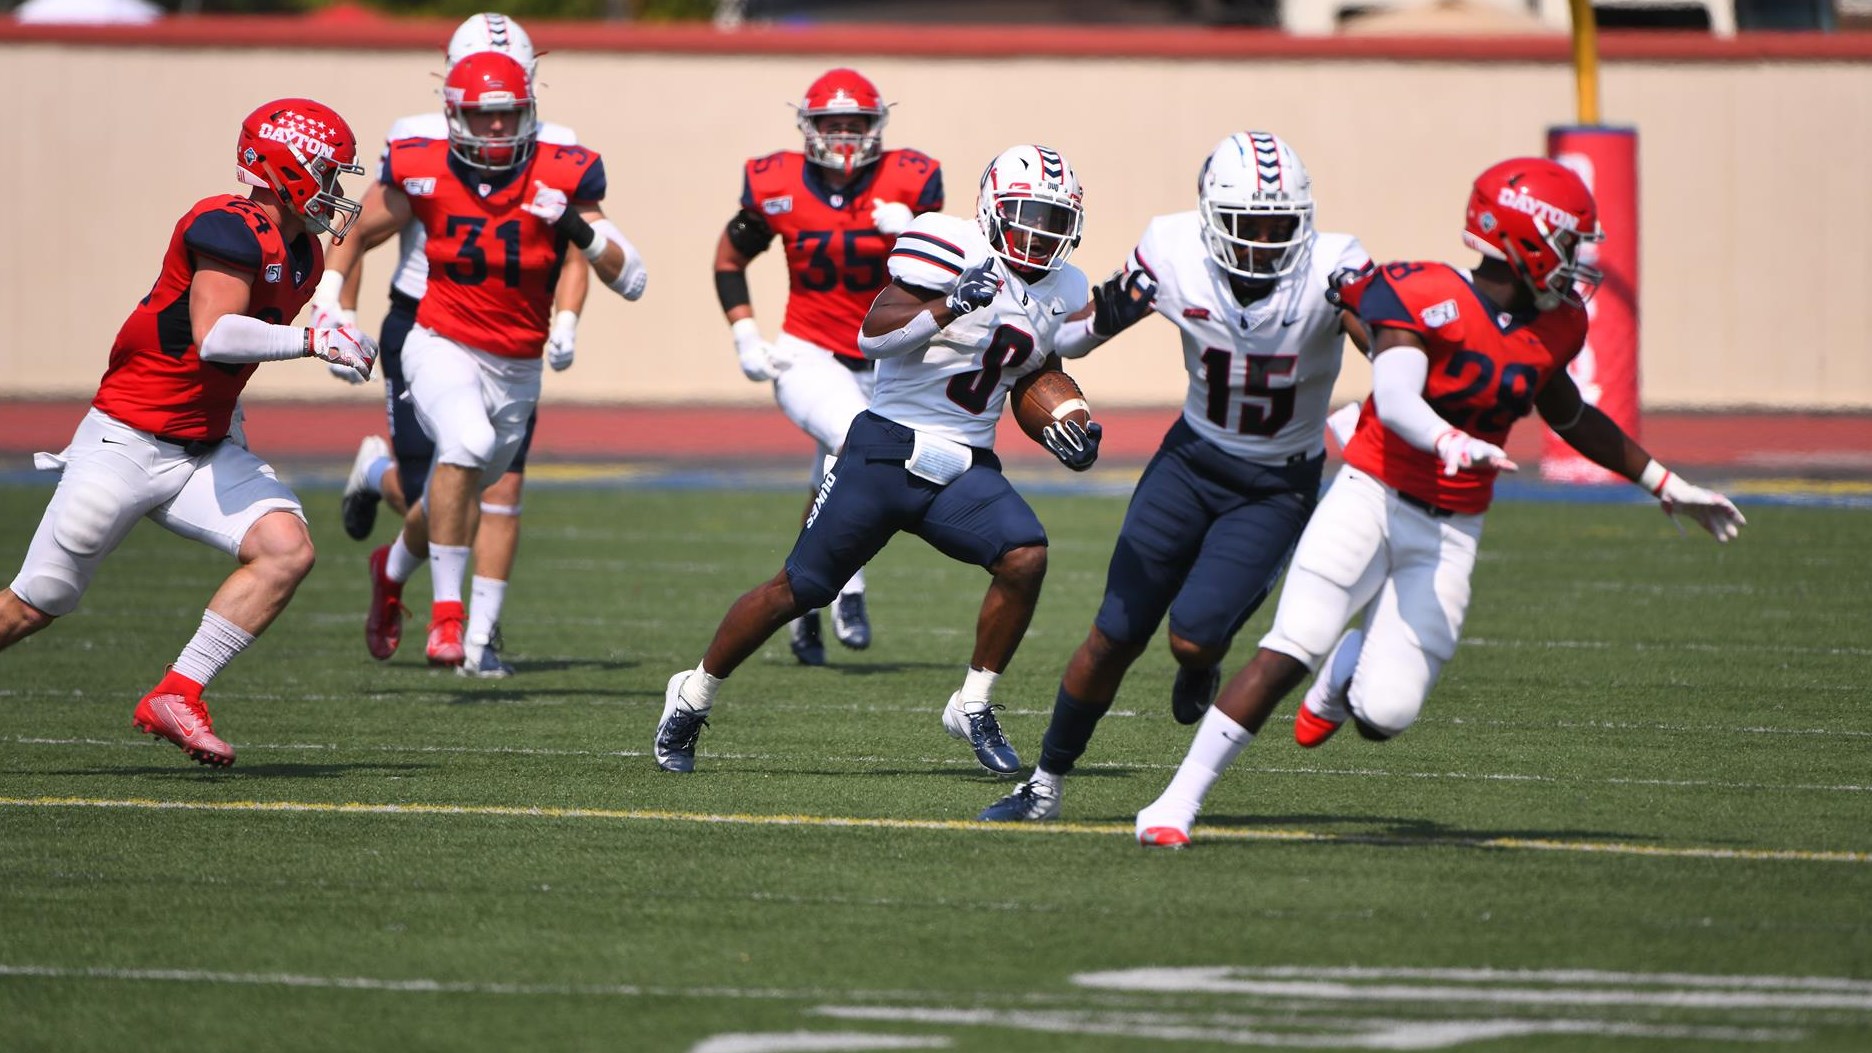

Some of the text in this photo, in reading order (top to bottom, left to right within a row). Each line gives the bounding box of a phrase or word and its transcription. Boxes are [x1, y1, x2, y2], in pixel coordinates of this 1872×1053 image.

[258, 122, 336, 159] DAYTON
[1498, 187, 1580, 231] DAYTON
[445, 215, 522, 289] 31
[796, 229, 884, 293] 35
[1202, 346, 1298, 438] 15
[1432, 349, 1539, 433] 28
[806, 472, 837, 529] DUKES
